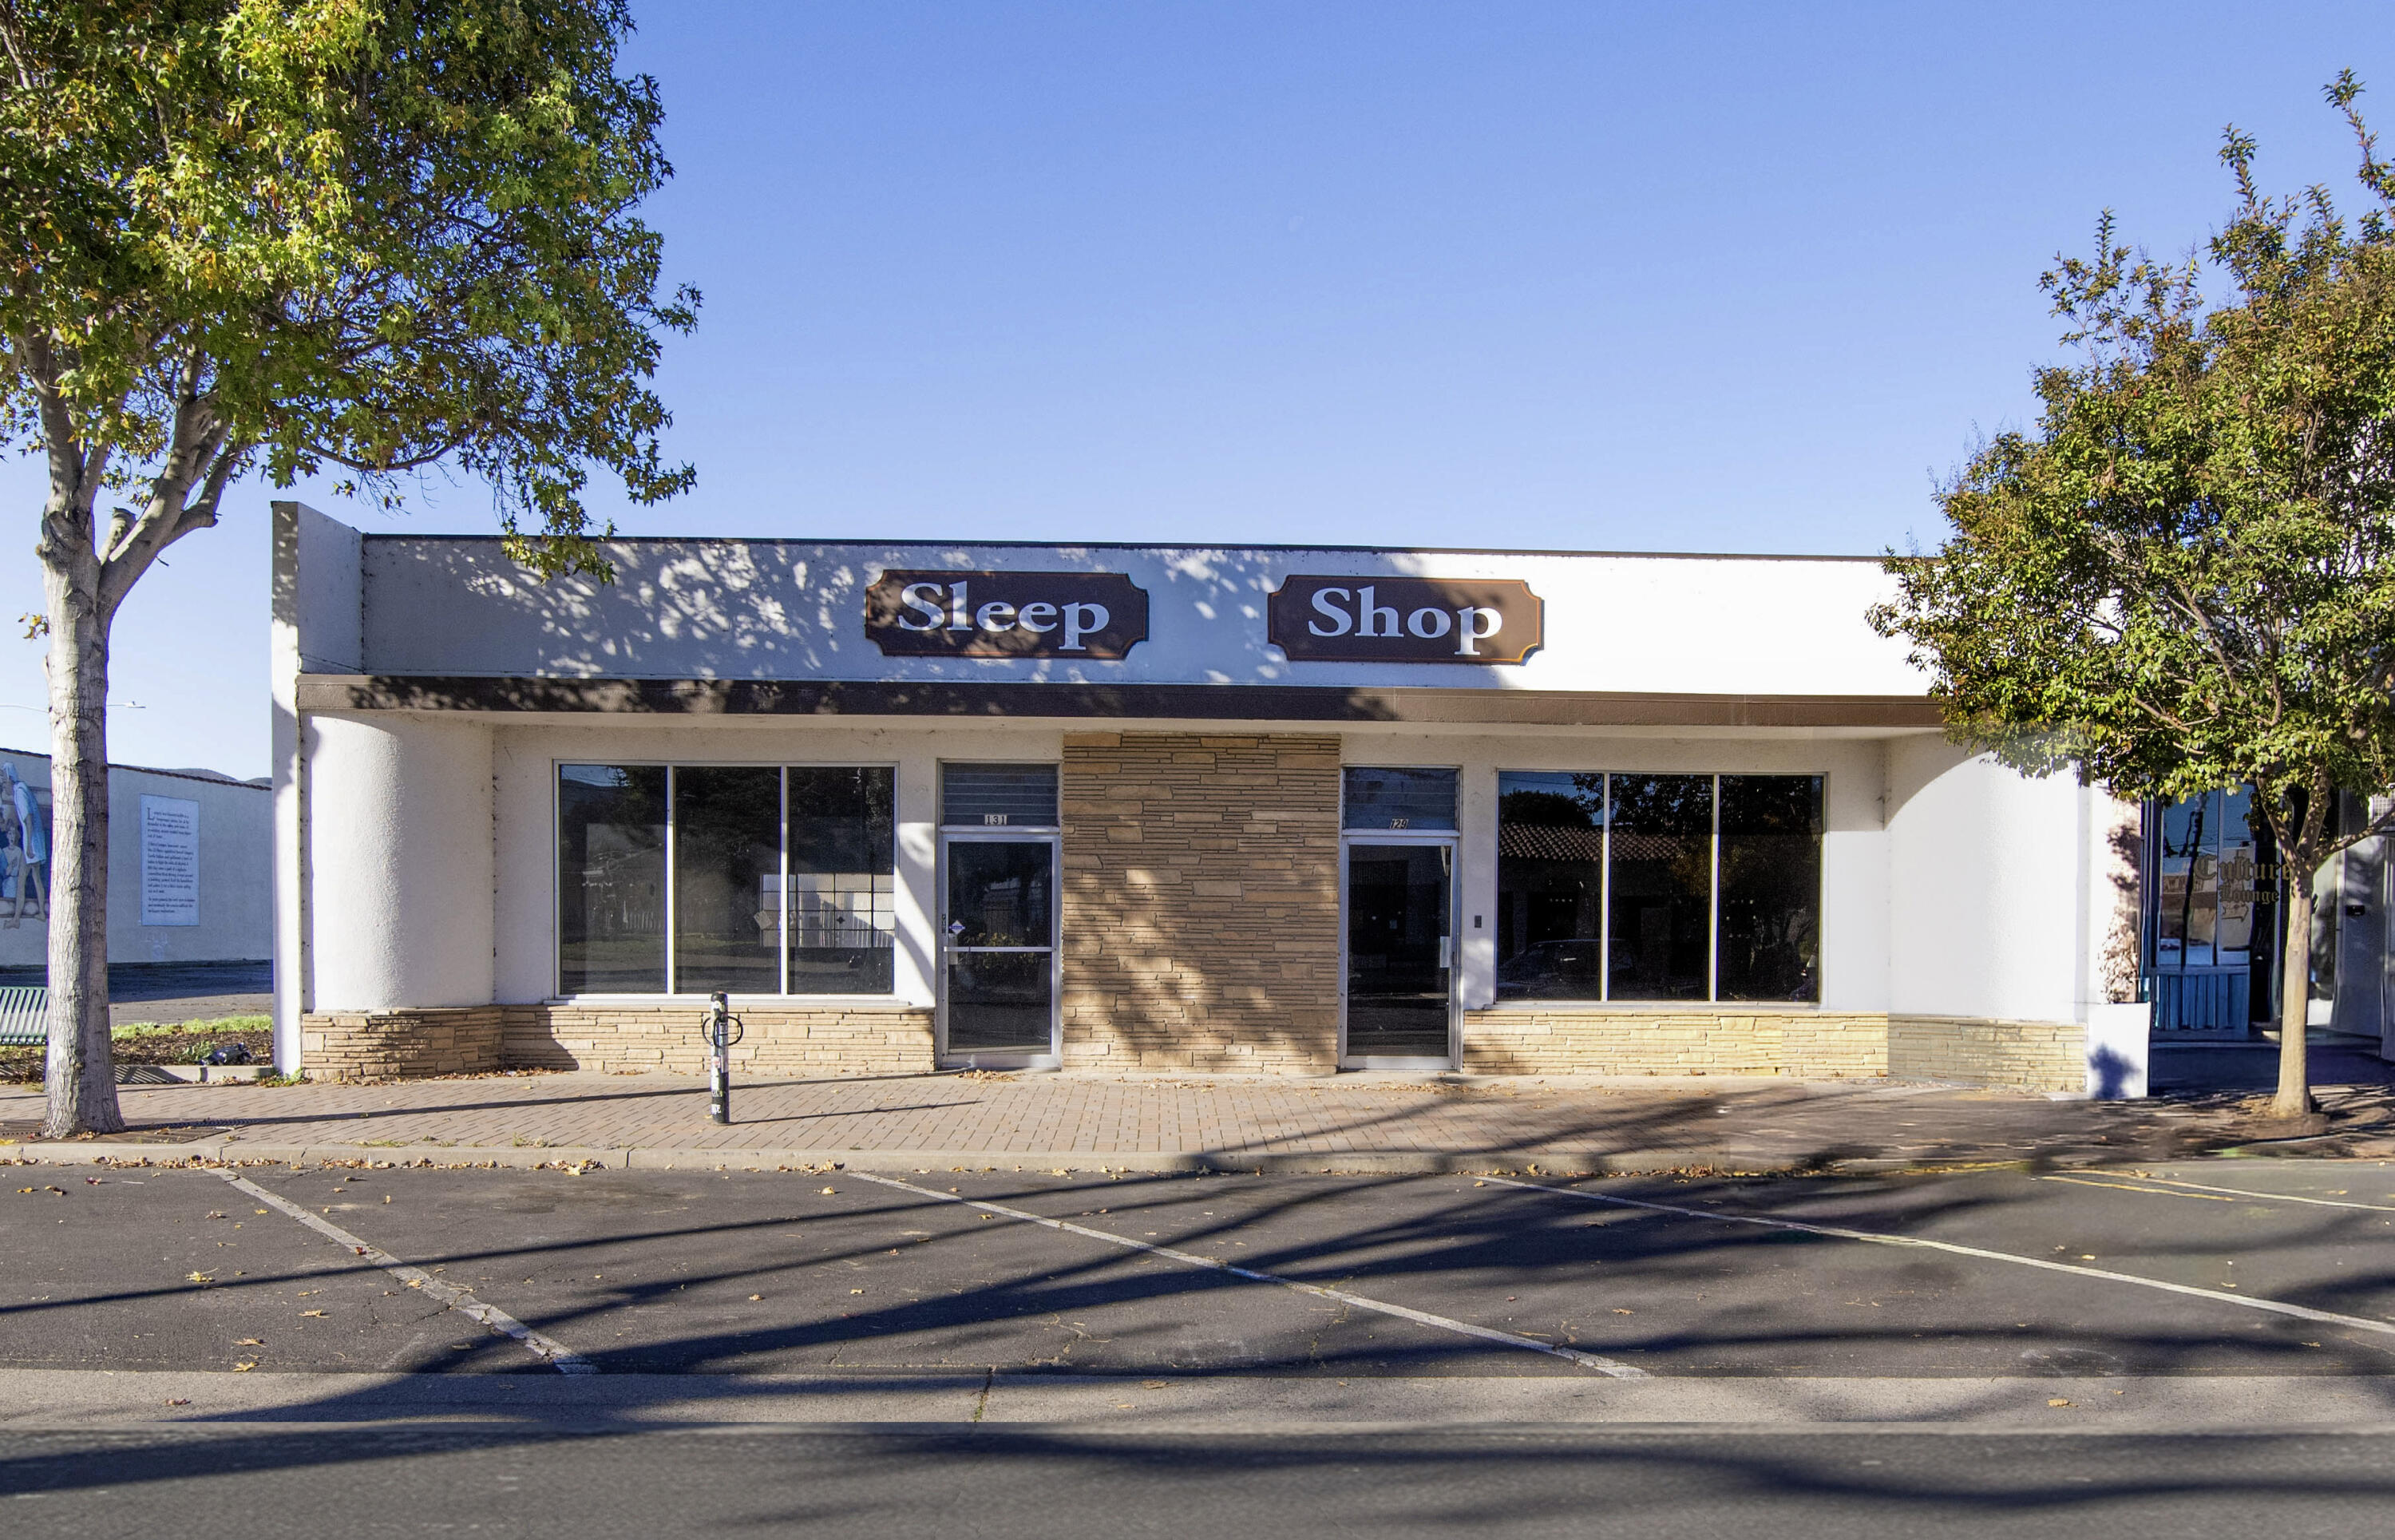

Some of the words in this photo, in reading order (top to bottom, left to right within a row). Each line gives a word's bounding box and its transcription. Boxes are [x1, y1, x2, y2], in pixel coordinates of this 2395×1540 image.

[899, 580, 1110, 650] Sleep
[1308, 585, 1502, 655] Shop
[987, 815, 1005, 825] 131
[1391, 818, 1407, 829] 129
[2195, 854, 2291, 881] Culture
[2219, 883, 2279, 905] Lounge
